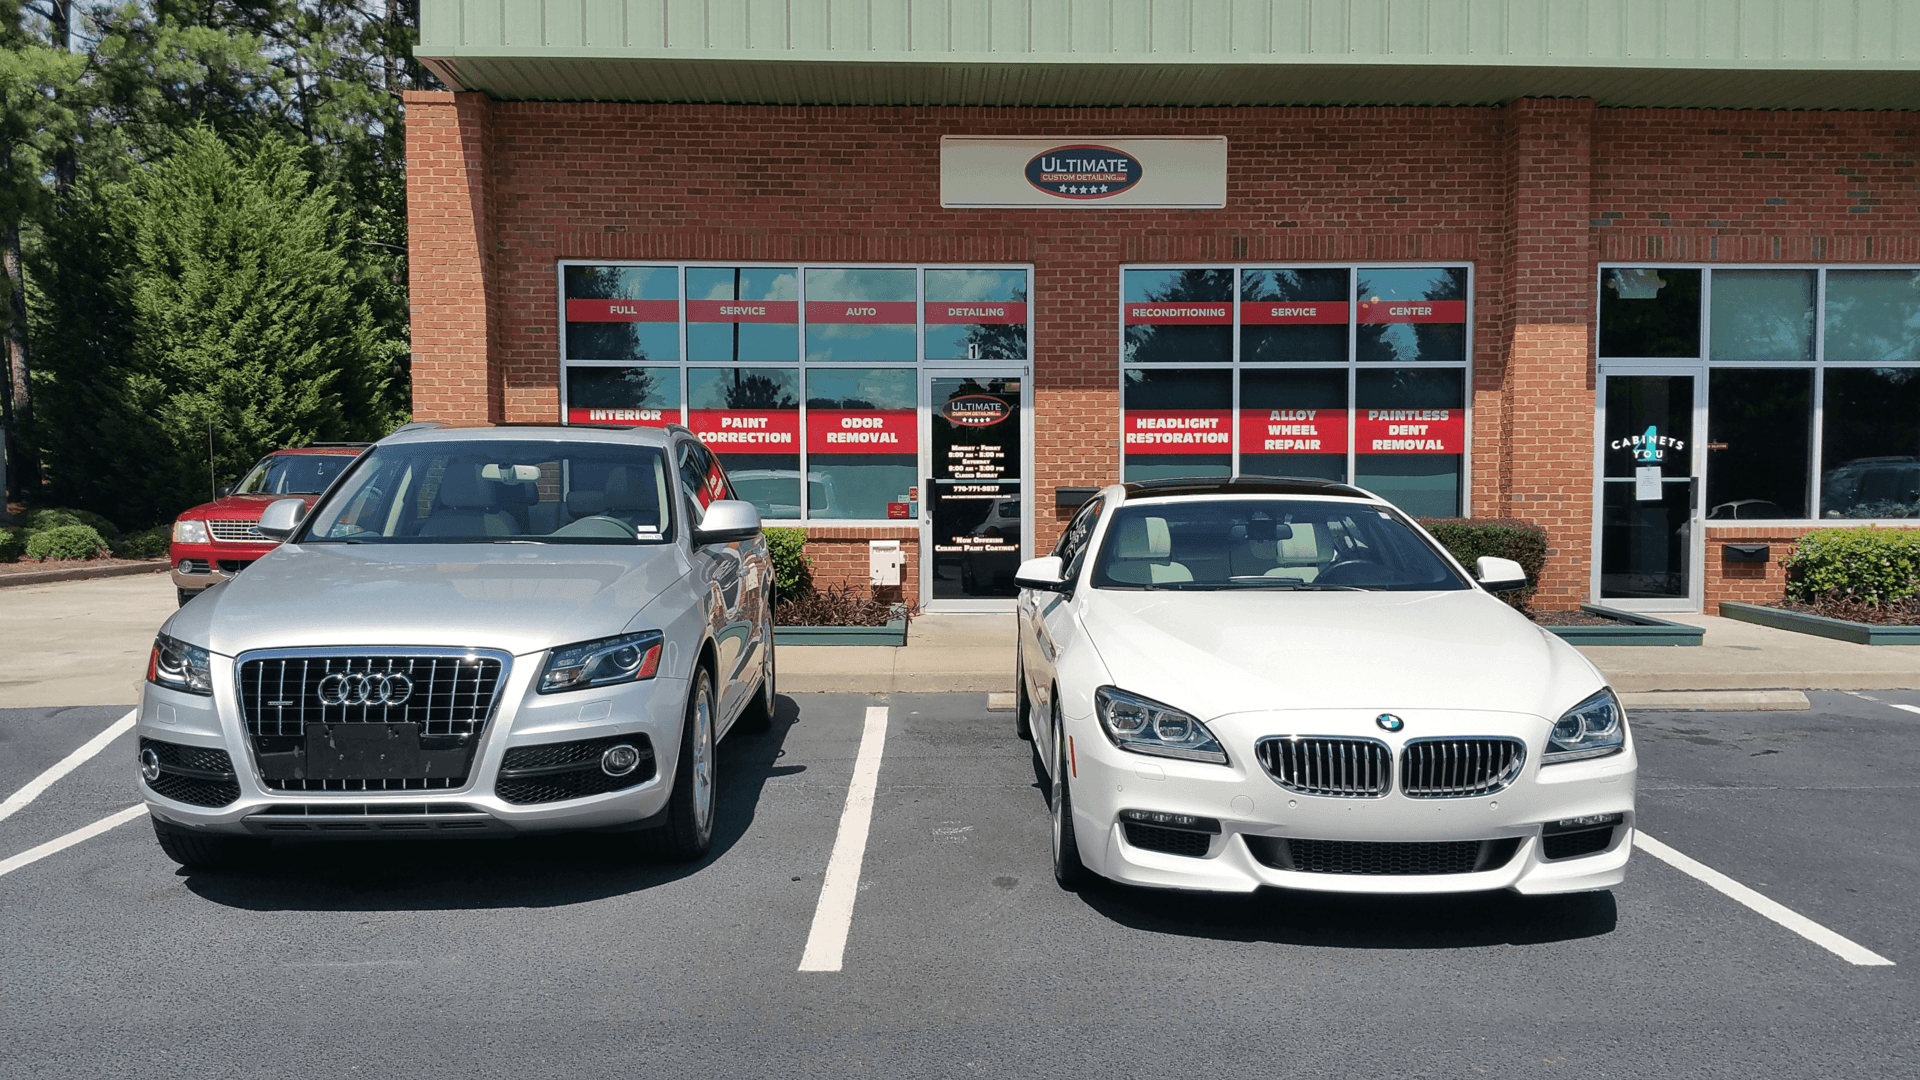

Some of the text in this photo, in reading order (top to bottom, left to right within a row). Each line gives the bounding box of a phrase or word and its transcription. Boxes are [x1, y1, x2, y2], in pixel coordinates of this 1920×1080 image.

[1041, 157, 1128, 172] ULTIMATE
[609, 305, 1005, 317] FULL SERVICE AUTO DETAILING
[1132, 306, 1432, 317] RECONDITIONING SERVICE CENTER
[970, 344, 976, 359] 1
[951, 401, 1002, 411] ULTIMATE
[589, 409, 662, 421] INTERIOR
[1269, 410, 1317, 421] ALLOY
[1368, 410, 1450, 421] PAINTLESS
[721, 417, 768, 429] PAINT
[841, 417, 884, 429] ODOR
[1136, 418, 1219, 429] HEADLIGHT
[1267, 425, 1318, 436] WHEEL
[1388, 425, 1429, 436] DENT
[697, 431, 792, 443] CORRECTION
[826, 432, 899, 443] REMOVAL
[1126, 432, 1229, 444] RESTORATION
[1611, 434, 1685, 451] CABINETS
[1264, 440, 1321, 450] REPAIR
[1372, 440, 1445, 450] REMOVAL
[1633, 449, 1663, 459] YOU
[934, 544, 962, 552] CERAMIC
[963, 544, 984, 552] PAINT
